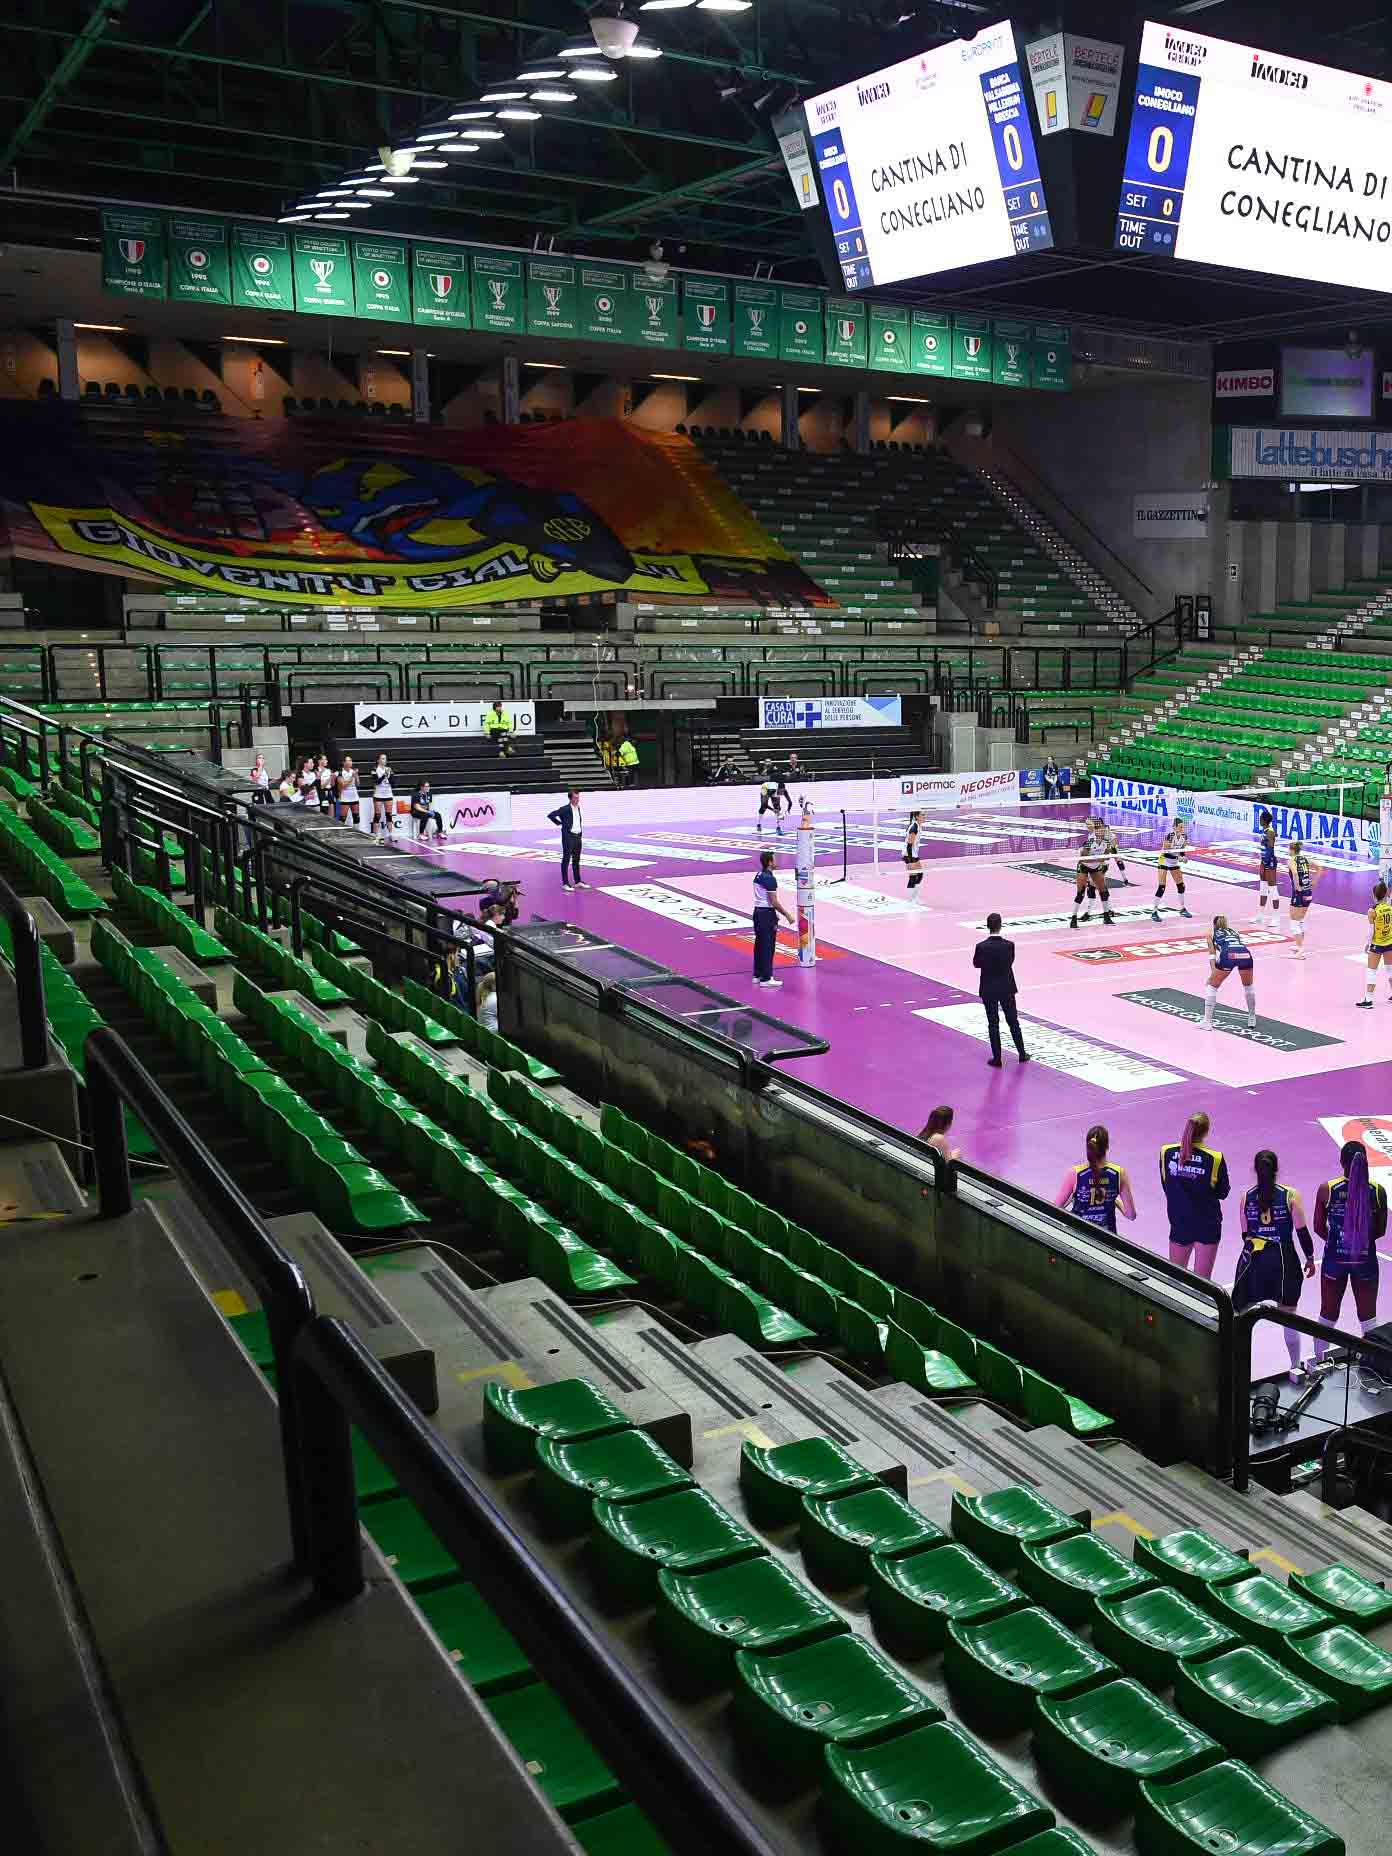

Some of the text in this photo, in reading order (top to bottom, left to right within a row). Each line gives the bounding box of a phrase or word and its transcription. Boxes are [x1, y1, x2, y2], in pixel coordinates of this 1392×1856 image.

[1155, 85, 1184, 101] IMOCO
[1138, 94, 1195, 116] CONEGLIANO
[1003, 124, 1024, 171] 0
[1147, 126, 1174, 173] 0
[871, 141, 968, 193] CANTINA DI
[1227, 144, 1388, 200] CANTINA DI
[833, 179, 850, 220] 0
[1007, 191, 1039, 210] SET 0
[1126, 192, 1174, 216] SET 0
[880, 186, 985, 235] CONEGLIANO
[1220, 190, 1391, 242] CONEGLIANO
[1011, 221, 1029, 236] TIME
[1119, 218, 1147, 235] TIME
[1015, 237, 1031, 251] OUT
[1119, 233, 1144, 249] OUT
[842, 262, 857, 276] TIME
[846, 276, 859, 289] OUT
[1216, 375, 1273, 392] KIMBO
[1146, 510, 1207, 521] GAZZETTIN
[765, 701, 787, 712] CASA
[401, 714, 437, 729] CA'
[449, 715, 468, 728] DI
[766, 712, 794, 724] CURA
[916, 780, 956, 793] permac
[960, 771, 1016, 796] NEOSPED
[1252, 804, 1358, 852] DHALMA
[1124, 993, 1182, 1016] MASTER
[1239, 1027, 1297, 1049] SPORT
